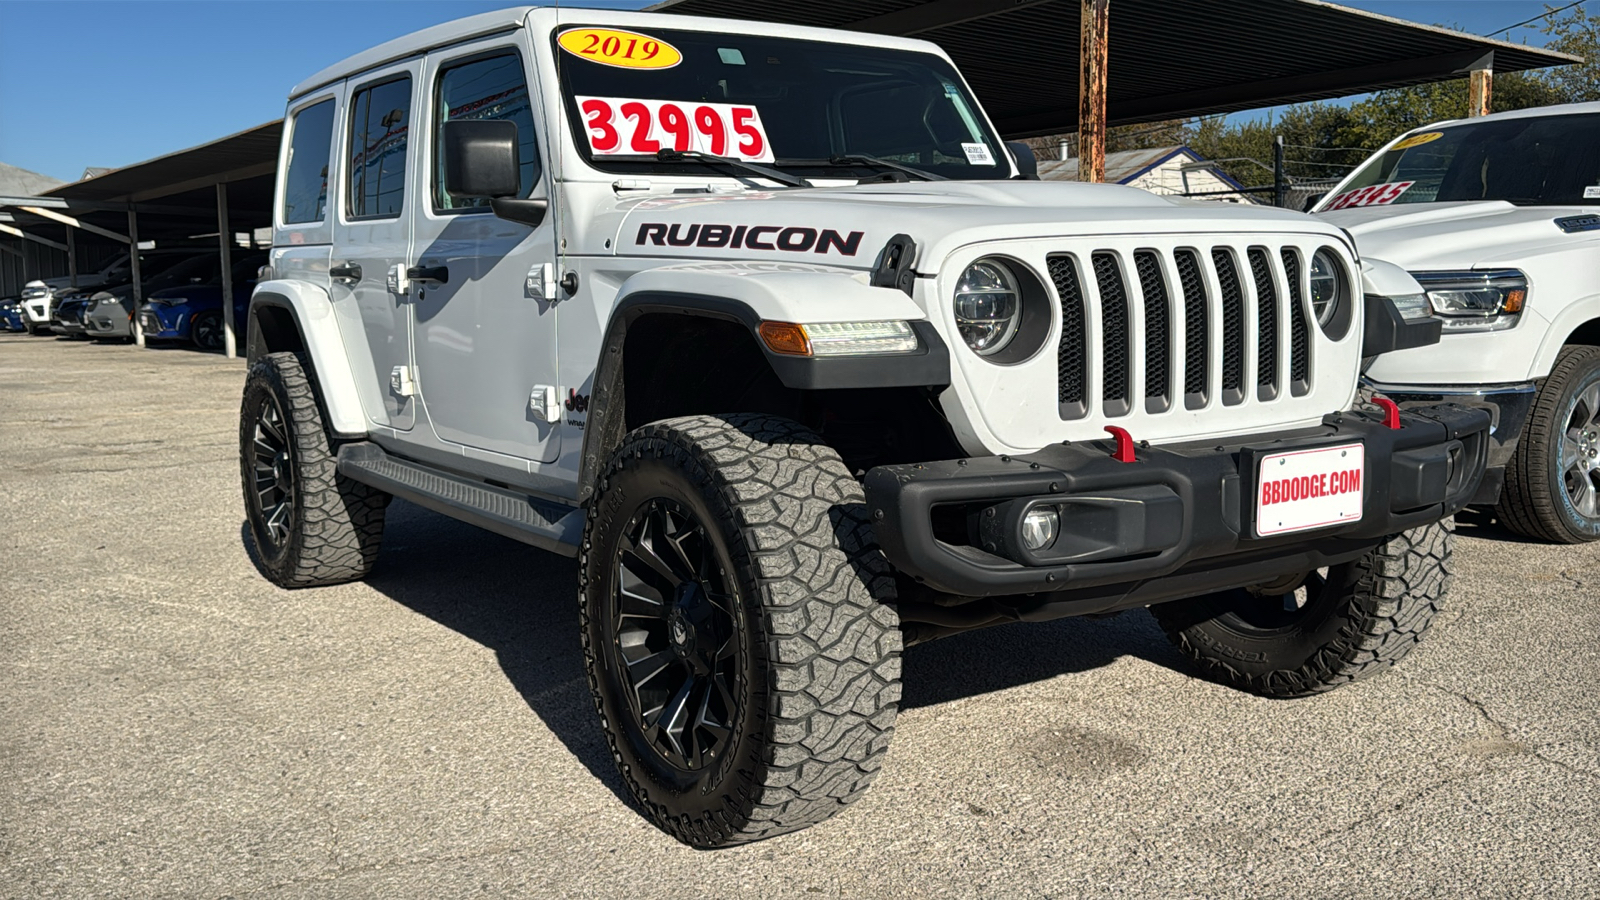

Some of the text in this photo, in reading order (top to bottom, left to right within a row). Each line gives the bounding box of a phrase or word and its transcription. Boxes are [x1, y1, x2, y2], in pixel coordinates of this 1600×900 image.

[580, 34, 659, 61] 2019
[582, 99, 765, 159] 32995
[635, 223, 865, 256] RUBICON
[1262, 468, 1361, 506] BBDODGE.COM
